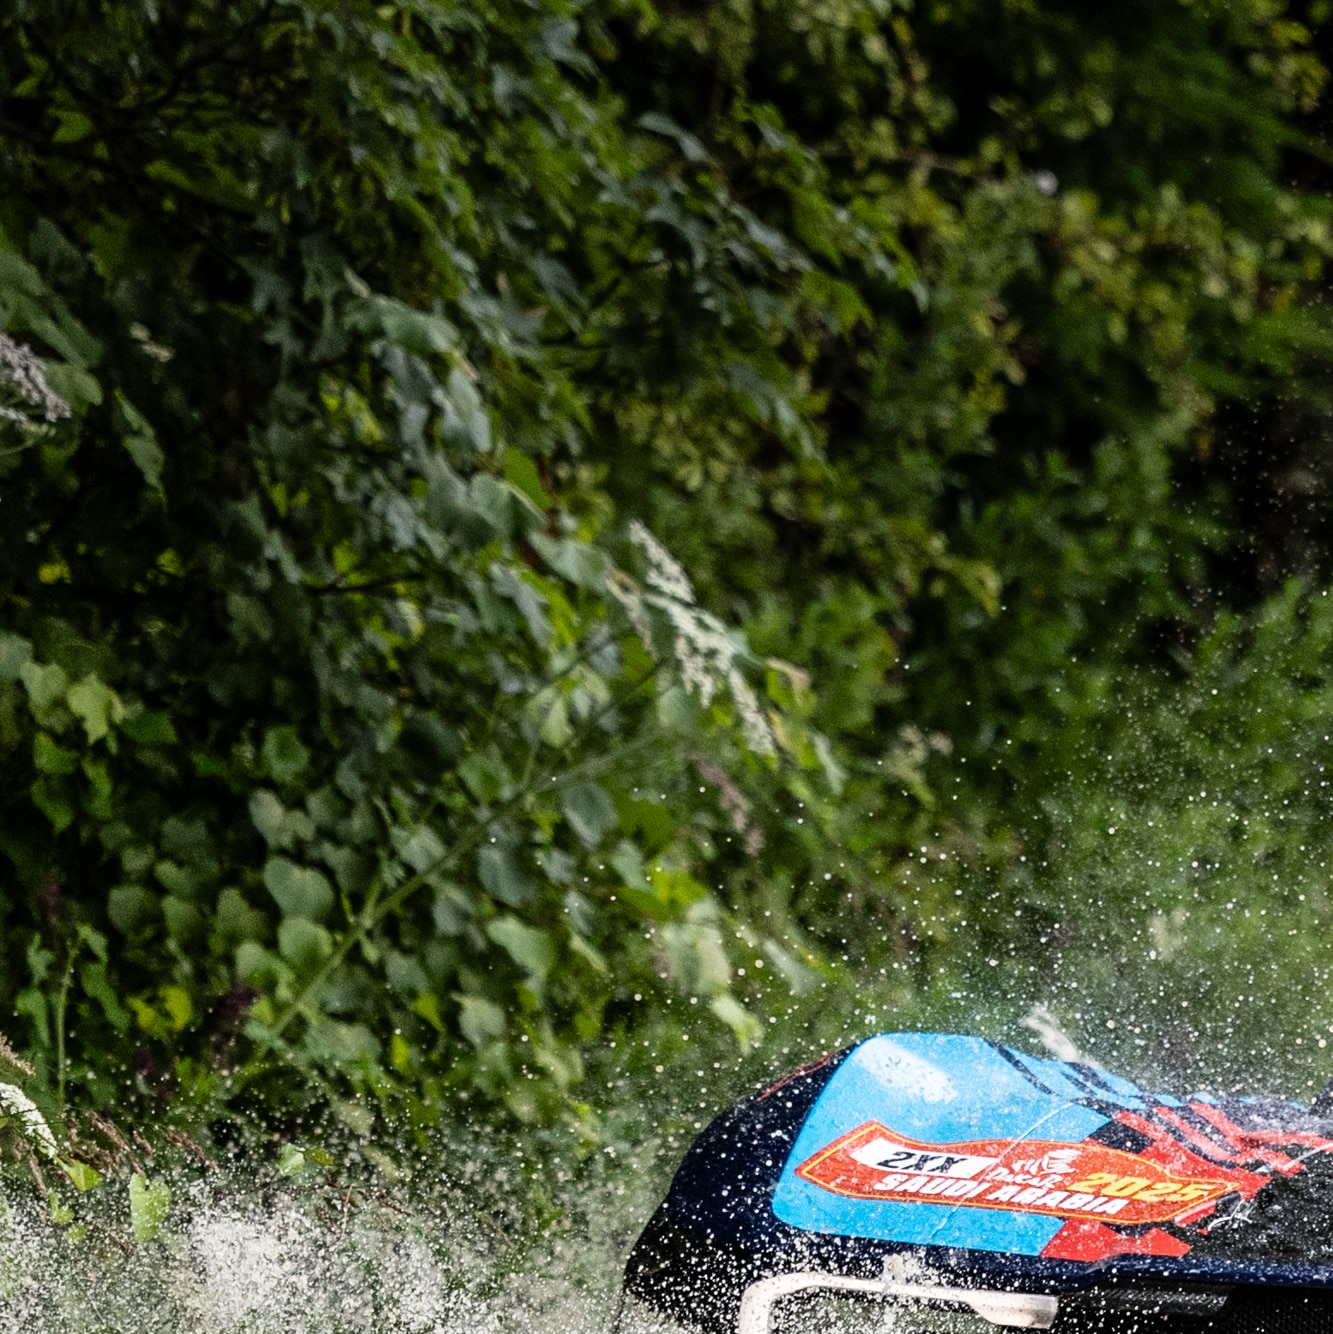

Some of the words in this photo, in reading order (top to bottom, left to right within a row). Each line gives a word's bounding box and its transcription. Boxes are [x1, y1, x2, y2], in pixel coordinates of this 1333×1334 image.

[876, 1151, 968, 1175] 2XX
[873, 1173, 988, 1200] SAUDI
[985, 1184, 1130, 1215] ARABIA
[1066, 1171, 1216, 1202] 2025
